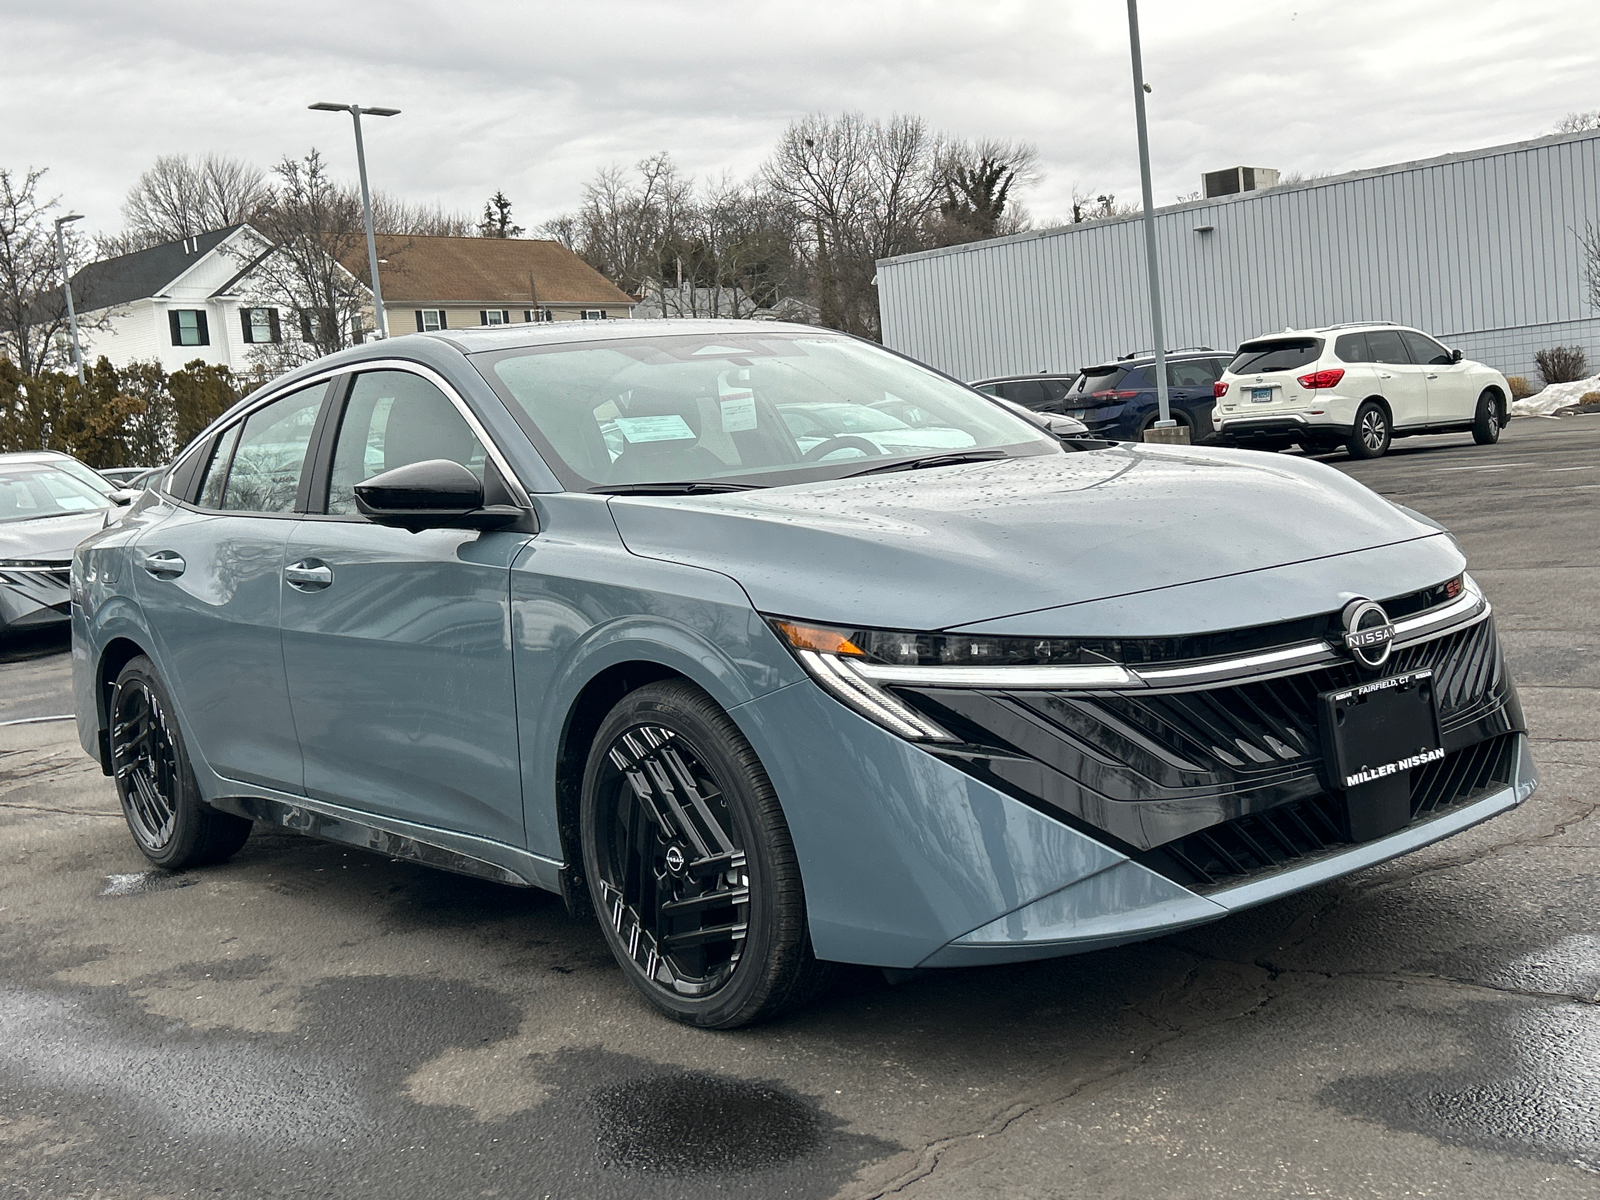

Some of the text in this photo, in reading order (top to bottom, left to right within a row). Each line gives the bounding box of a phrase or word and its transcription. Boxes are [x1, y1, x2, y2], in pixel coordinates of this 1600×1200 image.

[1348, 627, 1396, 647] NISSAN
[1358, 675, 1410, 695] FAIRFIELD, CT
[1346, 747, 1445, 787] MILLER NISSAN
